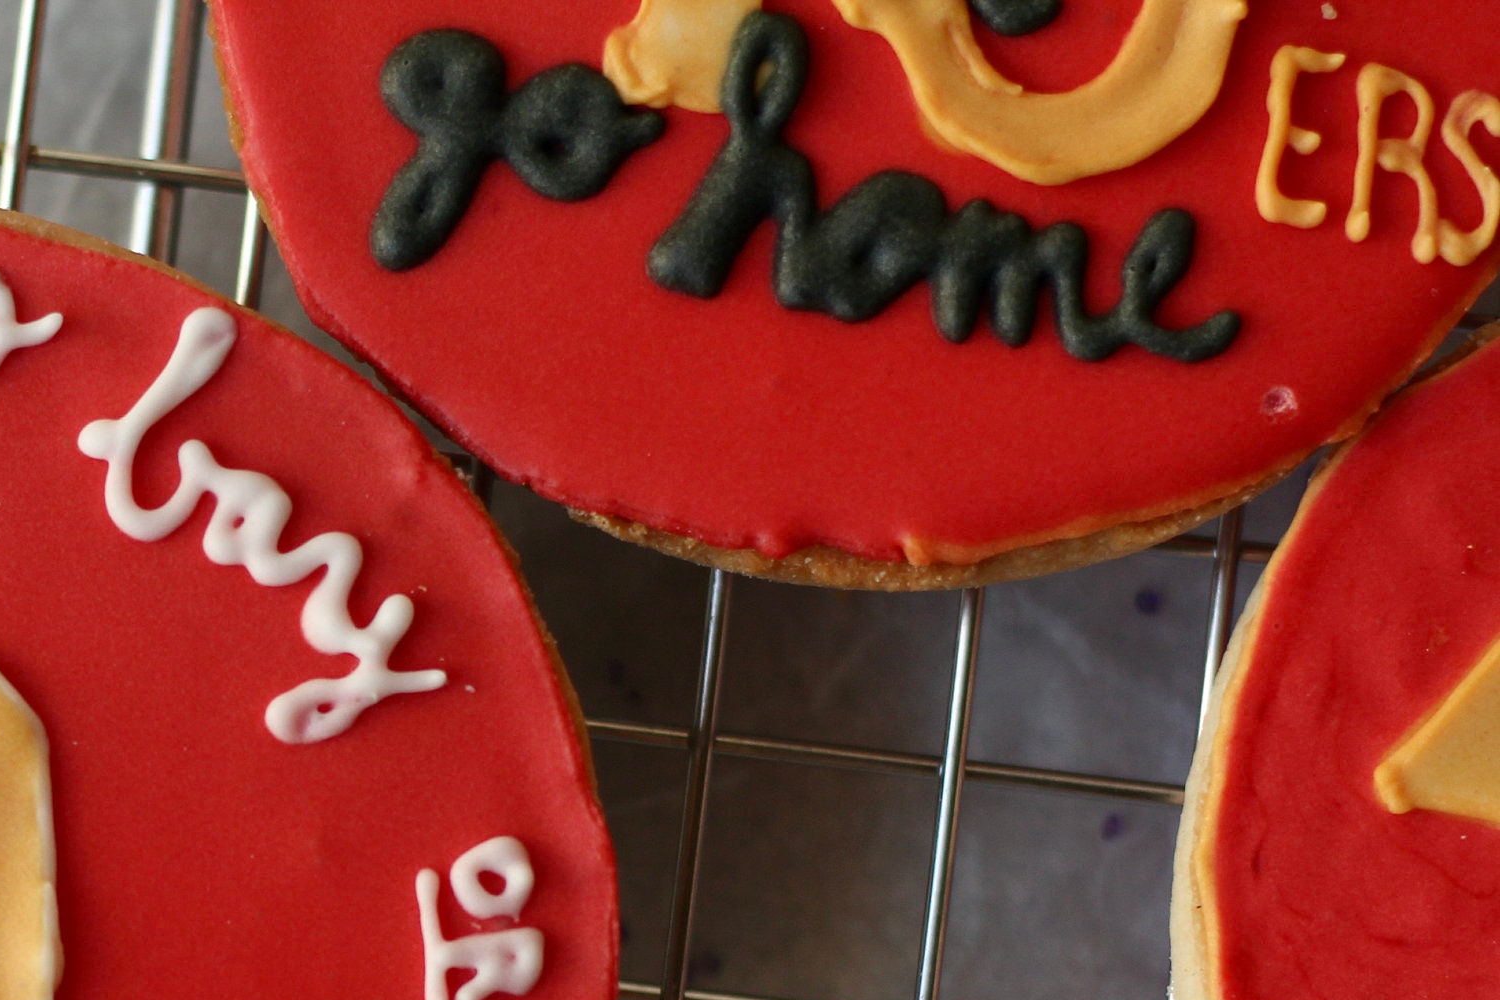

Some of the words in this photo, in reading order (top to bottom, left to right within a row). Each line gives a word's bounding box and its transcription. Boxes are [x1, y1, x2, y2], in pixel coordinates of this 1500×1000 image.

[370, 27, 667, 273] go
[646, 9, 1243, 362] home
[1255, 44, 1500, 267] ERS
[77, 306, 447, 744] bay
